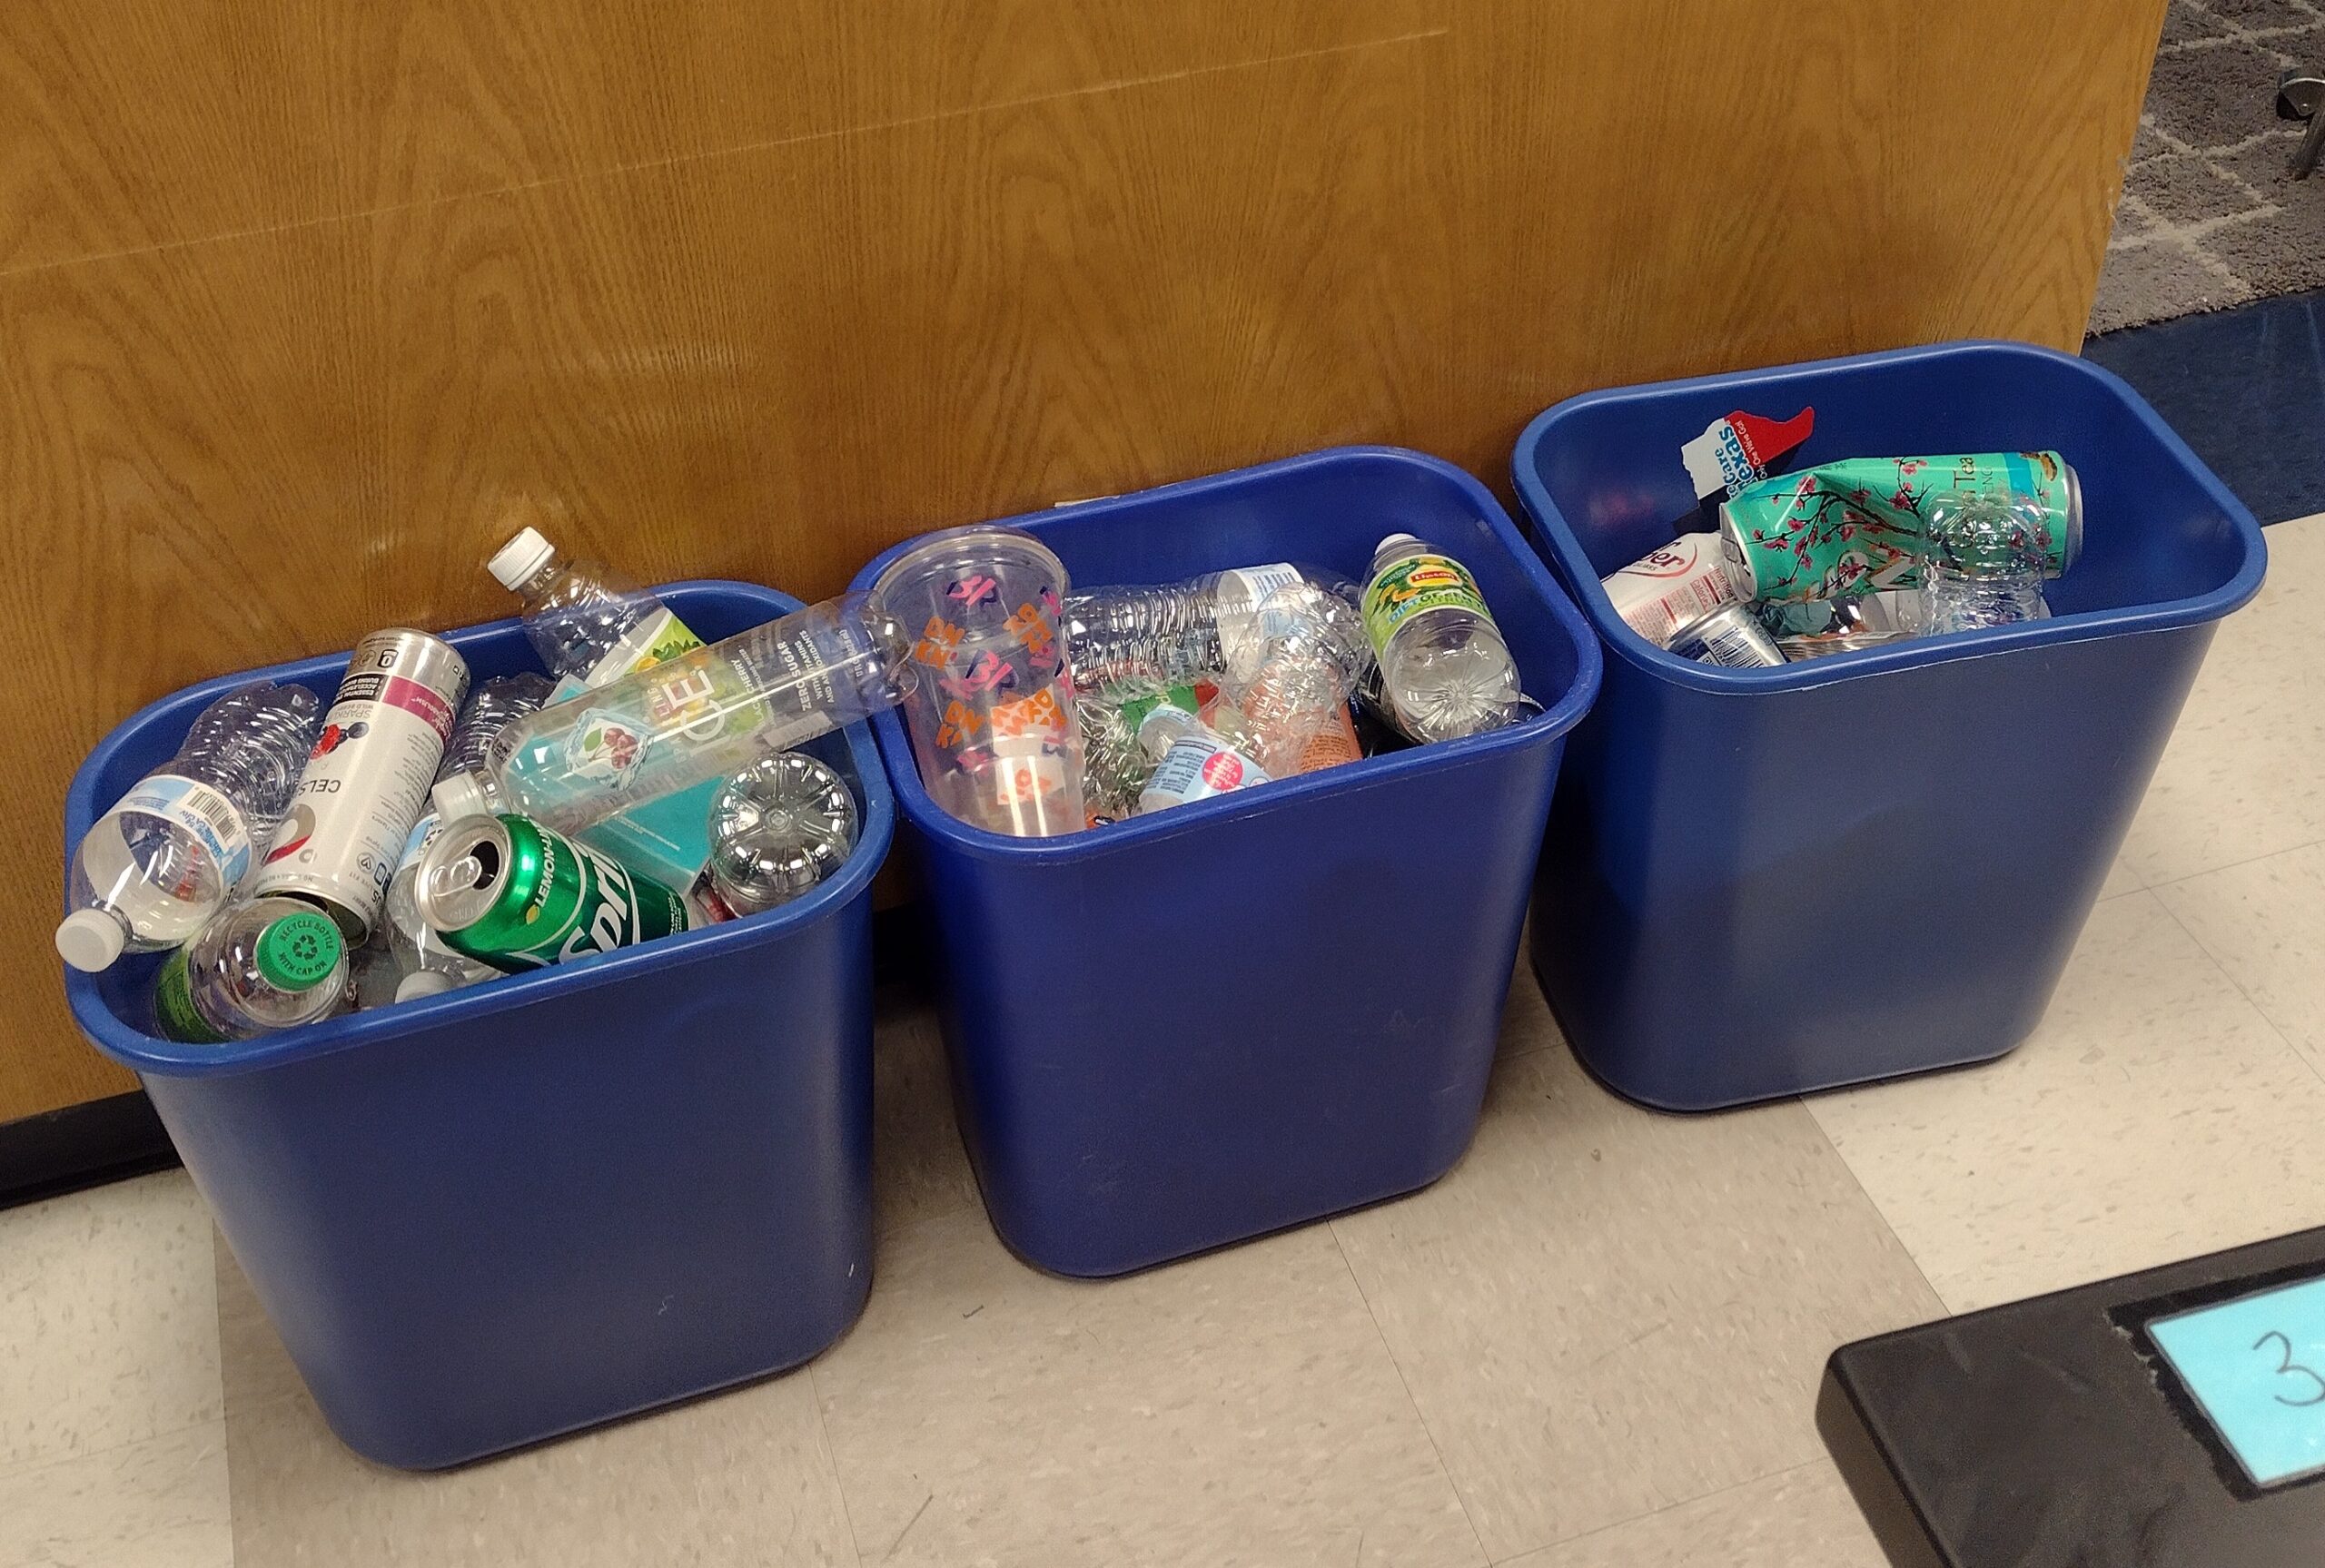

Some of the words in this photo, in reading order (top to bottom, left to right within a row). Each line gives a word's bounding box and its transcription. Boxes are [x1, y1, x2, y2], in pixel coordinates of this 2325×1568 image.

[1715, 448, 1736, 485] Care
[1751, 450, 1761, 466] One
[1756, 464, 1767, 479] Only
[1953, 457, 1976, 488] Tea
[1413, 570, 1456, 581] Lipton
[1713, 567, 1735, 599] Nutrition
[777, 641, 801, 679] SUGAR
[730, 659, 755, 695] CHERRY
[796, 680, 813, 712] ZERO
[826, 685, 836, 705] AND
[661, 670, 731, 757] ICE
[279, 919, 312, 942] RECYCLE
[313, 922, 334, 951] BOTTLE
[278, 952, 297, 972] WITH
[295, 967, 314, 976] CAP
[314, 960, 328, 972] ON
[2252, 1330, 2325, 1407] 3
